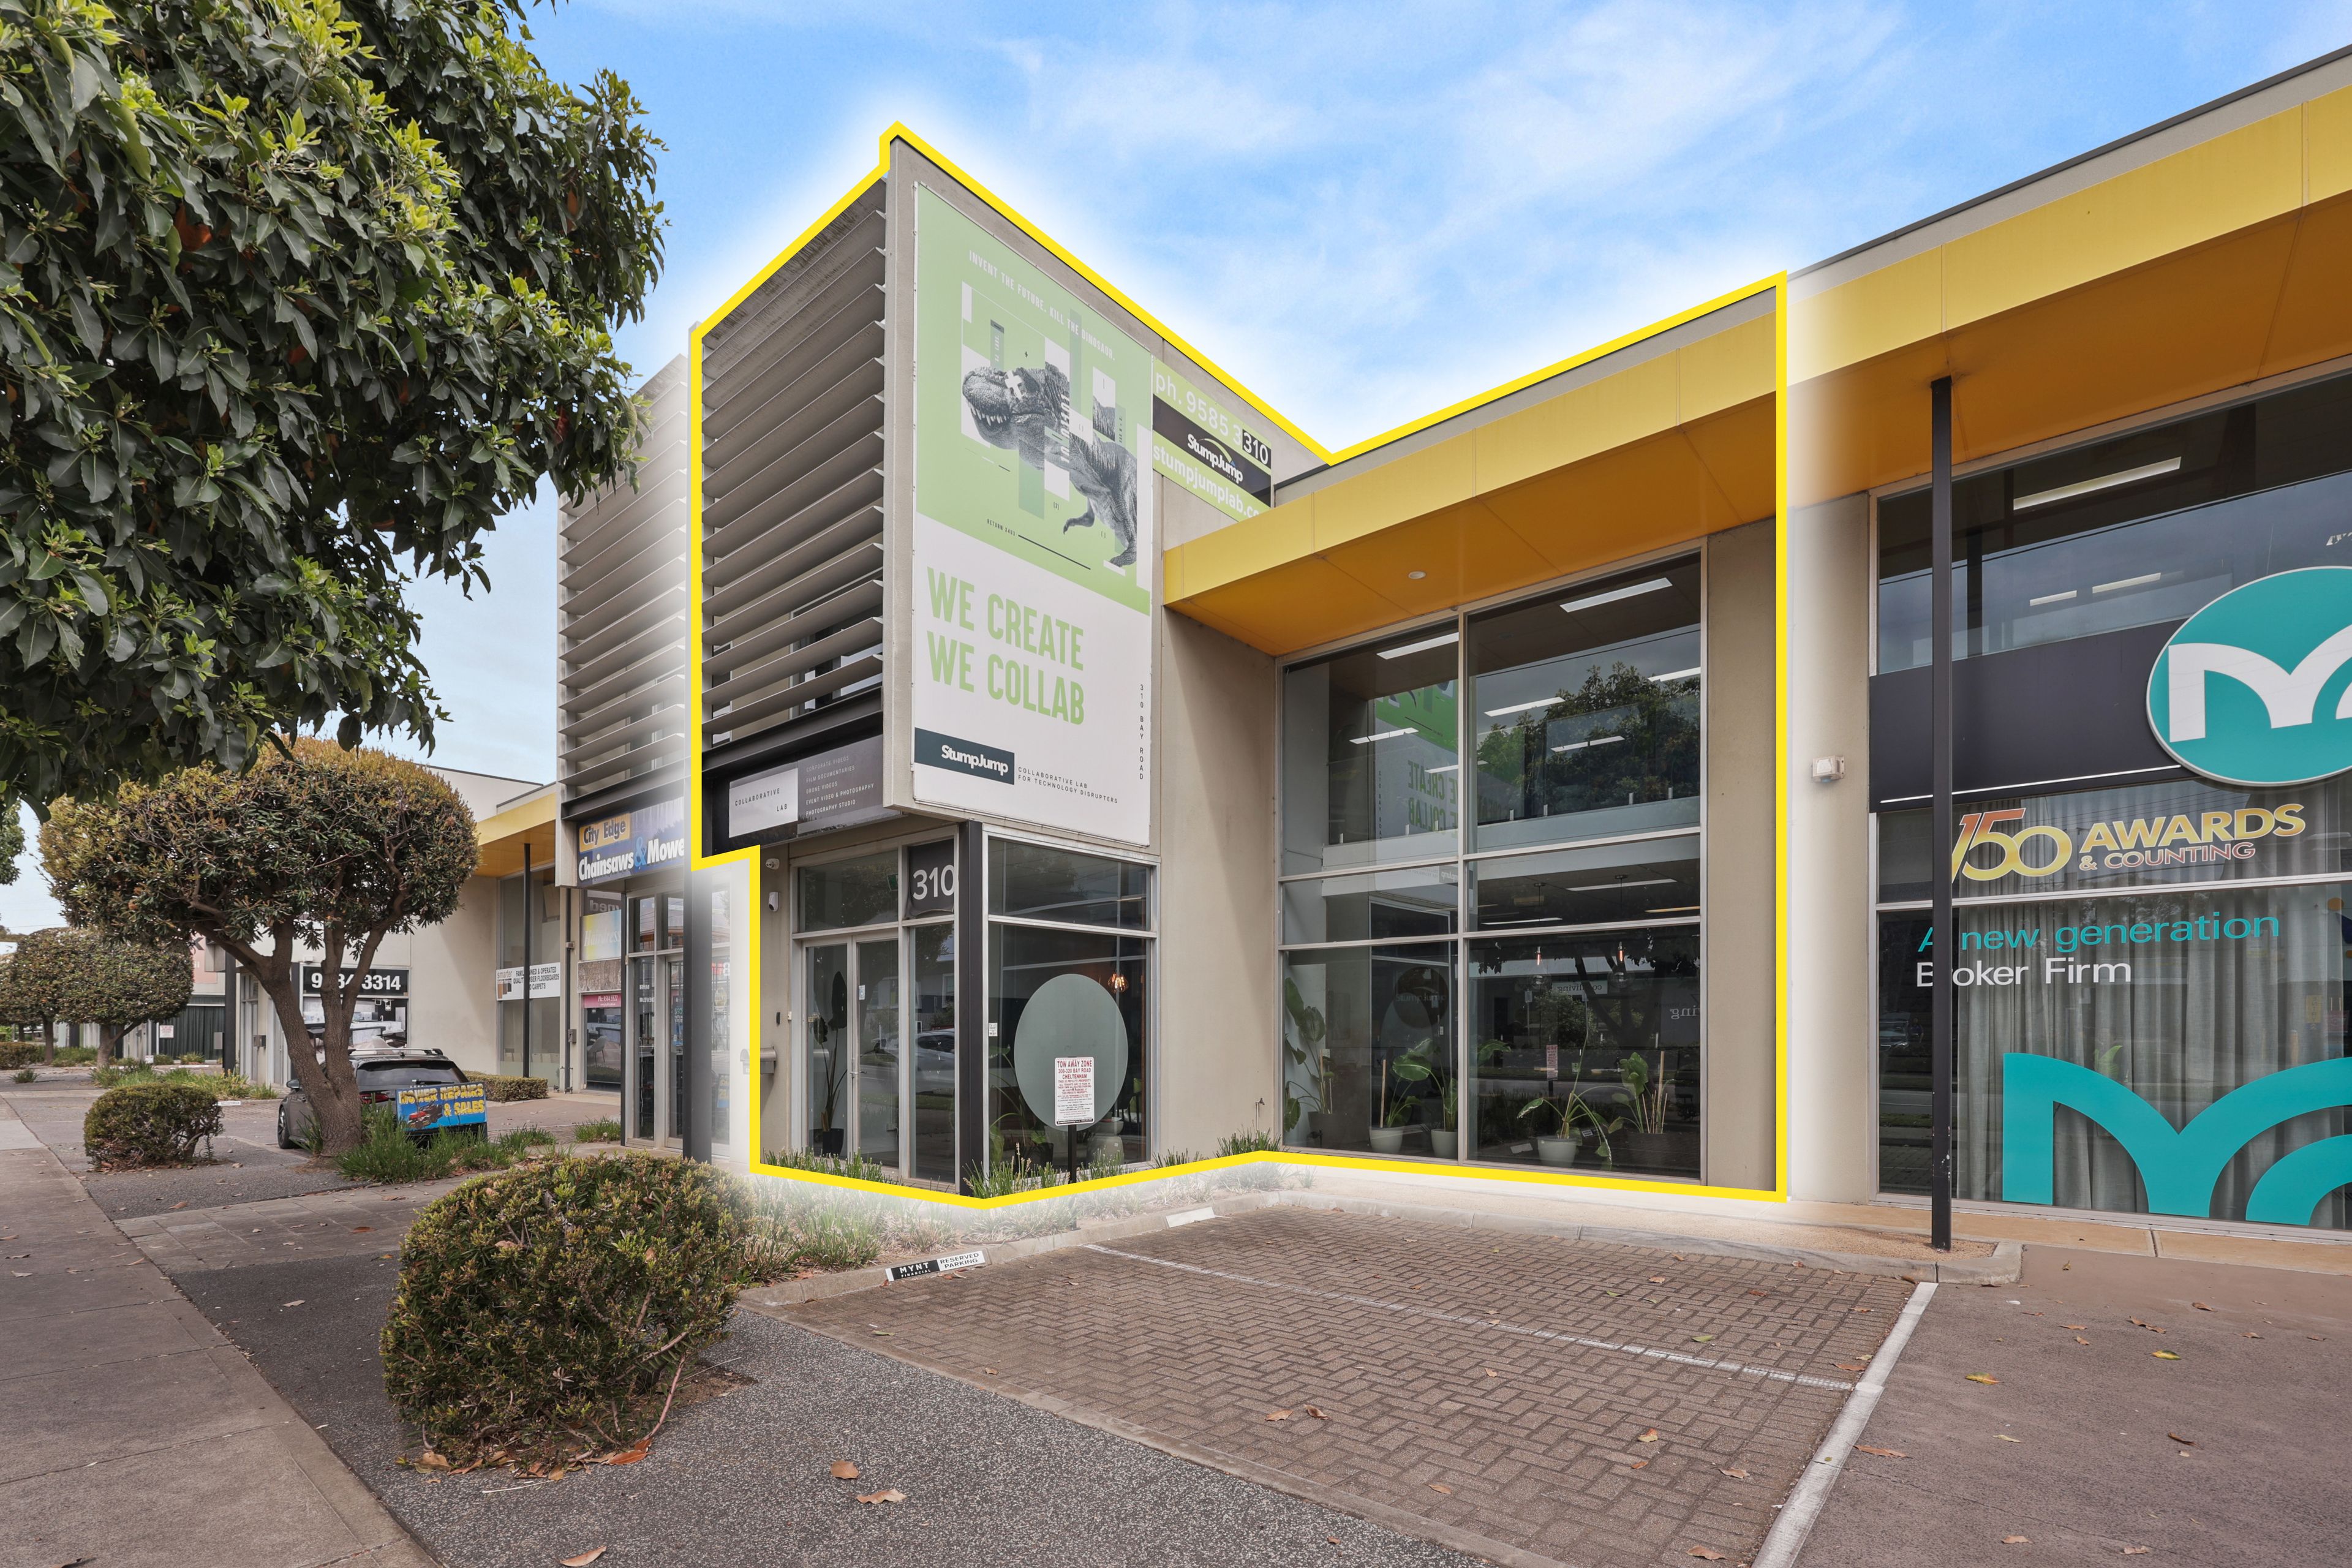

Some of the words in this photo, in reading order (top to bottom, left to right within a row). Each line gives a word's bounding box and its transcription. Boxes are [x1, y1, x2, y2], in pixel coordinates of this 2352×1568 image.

[970, 250, 997, 279] INVENT
[1001, 273, 1014, 290] THE
[1018, 284, 1047, 312] FUTURE.
[1049, 306, 1064, 325] KILL
[1067, 318, 1079, 335] THE
[1082, 328, 1115, 361] DINOSAUR.
[1156, 372, 1182, 405] ph.
[1186, 391, 1229, 437] 9585
[1187, 434, 1243, 484] StumpJump
[1243, 432, 1268, 465] 310
[987, 519, 1003, 530] RETURN
[927, 566, 974, 631] WE
[987, 593, 1084, 671] CREATE
[927, 630, 974, 693] WE
[987, 654, 1084, 725] COLLAB
[806, 761, 831, 772] CORPORATE
[833, 755, 849, 764] VIDEOS
[818, 766, 855, 780] DOCUMENTARIES
[941, 745, 1009, 776] StumpJump
[821, 781, 838, 790] VIDEOS
[840, 783, 874, 796] PHOTOGRAPHY
[1019, 767, 1072, 785] COLLABORATIVE
[1076, 780, 1088, 789] LAB
[1019, 774, 1031, 783] FOR
[1034, 778, 1077, 794] TECHNOLOGY
[1080, 790, 1118, 804] DISRUPTERS
[735, 788, 780, 806] COLLABORATIVE
[776, 804, 788, 812] LAB
[805, 804, 837, 816] PHOTOGRAPHY
[839, 799, 856, 809] STUDIO
[583, 826, 599, 845] City
[603, 820, 626, 840] Edge
[1952, 807, 2073, 883] 150
[2079, 803, 2306, 854] AWARDS
[578, 852, 634, 881] Chainsaws
[634, 837, 647, 867] &
[647, 838, 685, 864] Mowe
[2079, 855, 2098, 872] &
[2104, 842, 2255, 869] COUNTING
[913, 864, 954, 900] 310
[1962, 927, 2040, 951] new
[2055, 911, 2280, 952] generation
[361, 974, 401, 990] 3314
[1917, 962, 2029, 987] Boker
[2045, 957, 2132, 984] Firm
[398, 1088, 438, 1104] MOWER
[440, 1084, 484, 1099] REPAIRS
[444, 1104, 451, 1116] &
[454, 1099, 485, 1115] SALES
[899, 1262, 929, 1274] MYNT
[940, 1253, 979, 1264] RESERVED
[901, 1269, 931, 1278] FINANCIAL
[944, 1259, 978, 1268] PARKING
